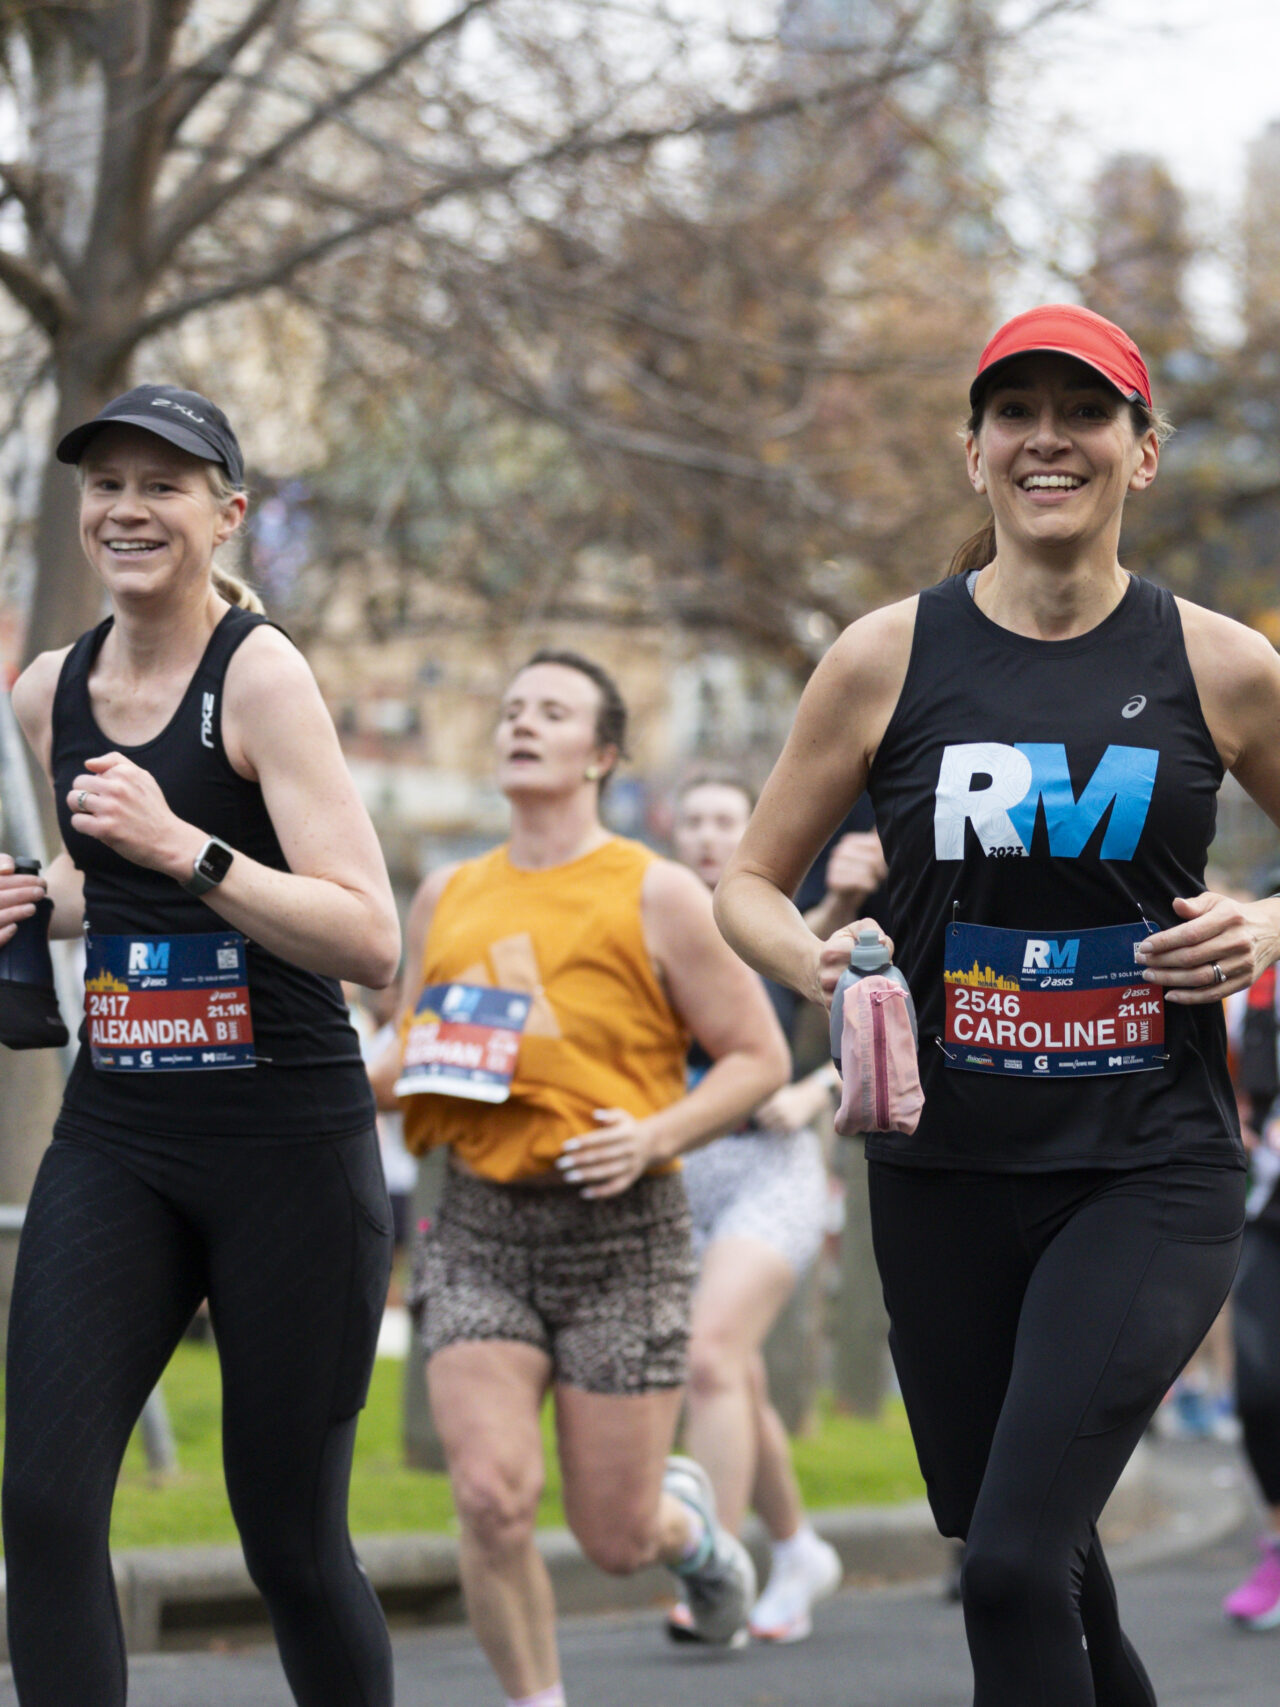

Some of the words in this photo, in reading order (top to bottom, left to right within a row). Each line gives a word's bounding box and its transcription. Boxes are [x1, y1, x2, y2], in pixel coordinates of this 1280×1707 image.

[151, 398, 205, 424] 2XU
[201, 691, 215, 749] 2XU
[934, 742, 1160, 861] RM
[988, 846, 1024, 858] 2023
[128, 942, 170, 970] RM
[1022, 939, 1080, 968] RM
[90, 995, 130, 1017] 2417
[207, 1003, 248, 1019] 21.1K
[954, 988, 1020, 1017] 2546
[1118, 1001, 1160, 1017] 21.1K
[92, 1018, 209, 1044] ALEXANDRA
[216, 1021, 228, 1041] B
[954, 1013, 1116, 1048] CAROLINE
[1126, 1022, 1138, 1042] B
[1140, 1020, 1149, 1042] WAVE
[140, 1050, 153, 1065] G
[1034, 1055, 1048, 1070] G
